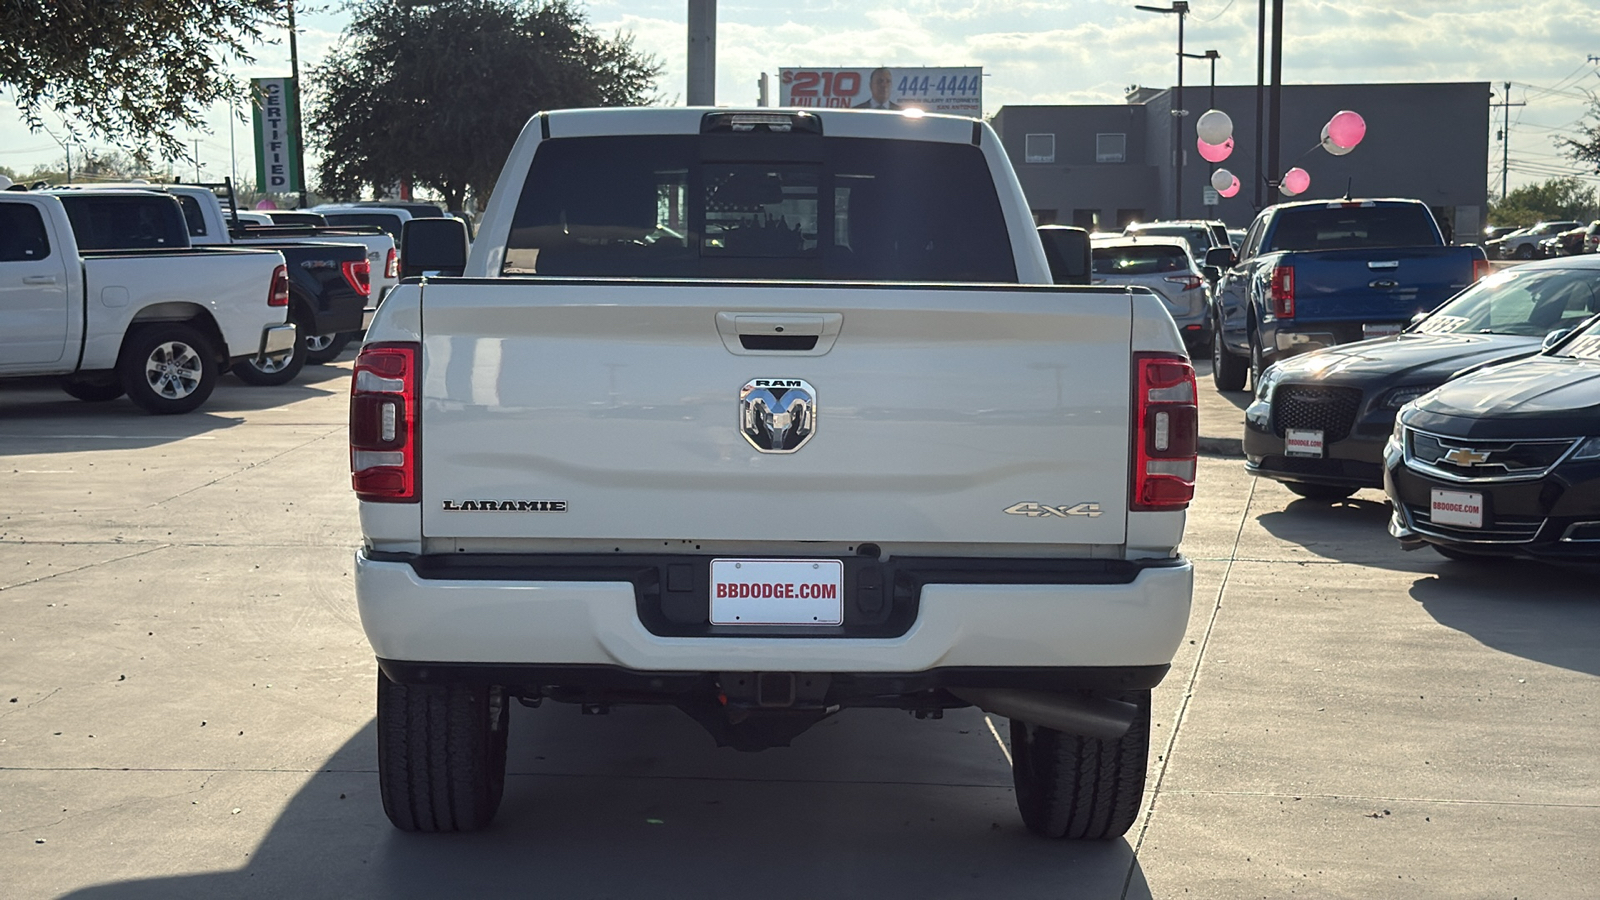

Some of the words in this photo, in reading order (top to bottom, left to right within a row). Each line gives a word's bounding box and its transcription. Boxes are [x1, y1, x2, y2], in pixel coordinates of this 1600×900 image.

[897, 75, 978, 96] 444-4444
[266, 84, 285, 186] CERTIFIED
[442, 500, 567, 512] LARAMIE
[1433, 501, 1480, 514] BBDODGE.COM
[716, 583, 837, 599] BBDODGE.COM
